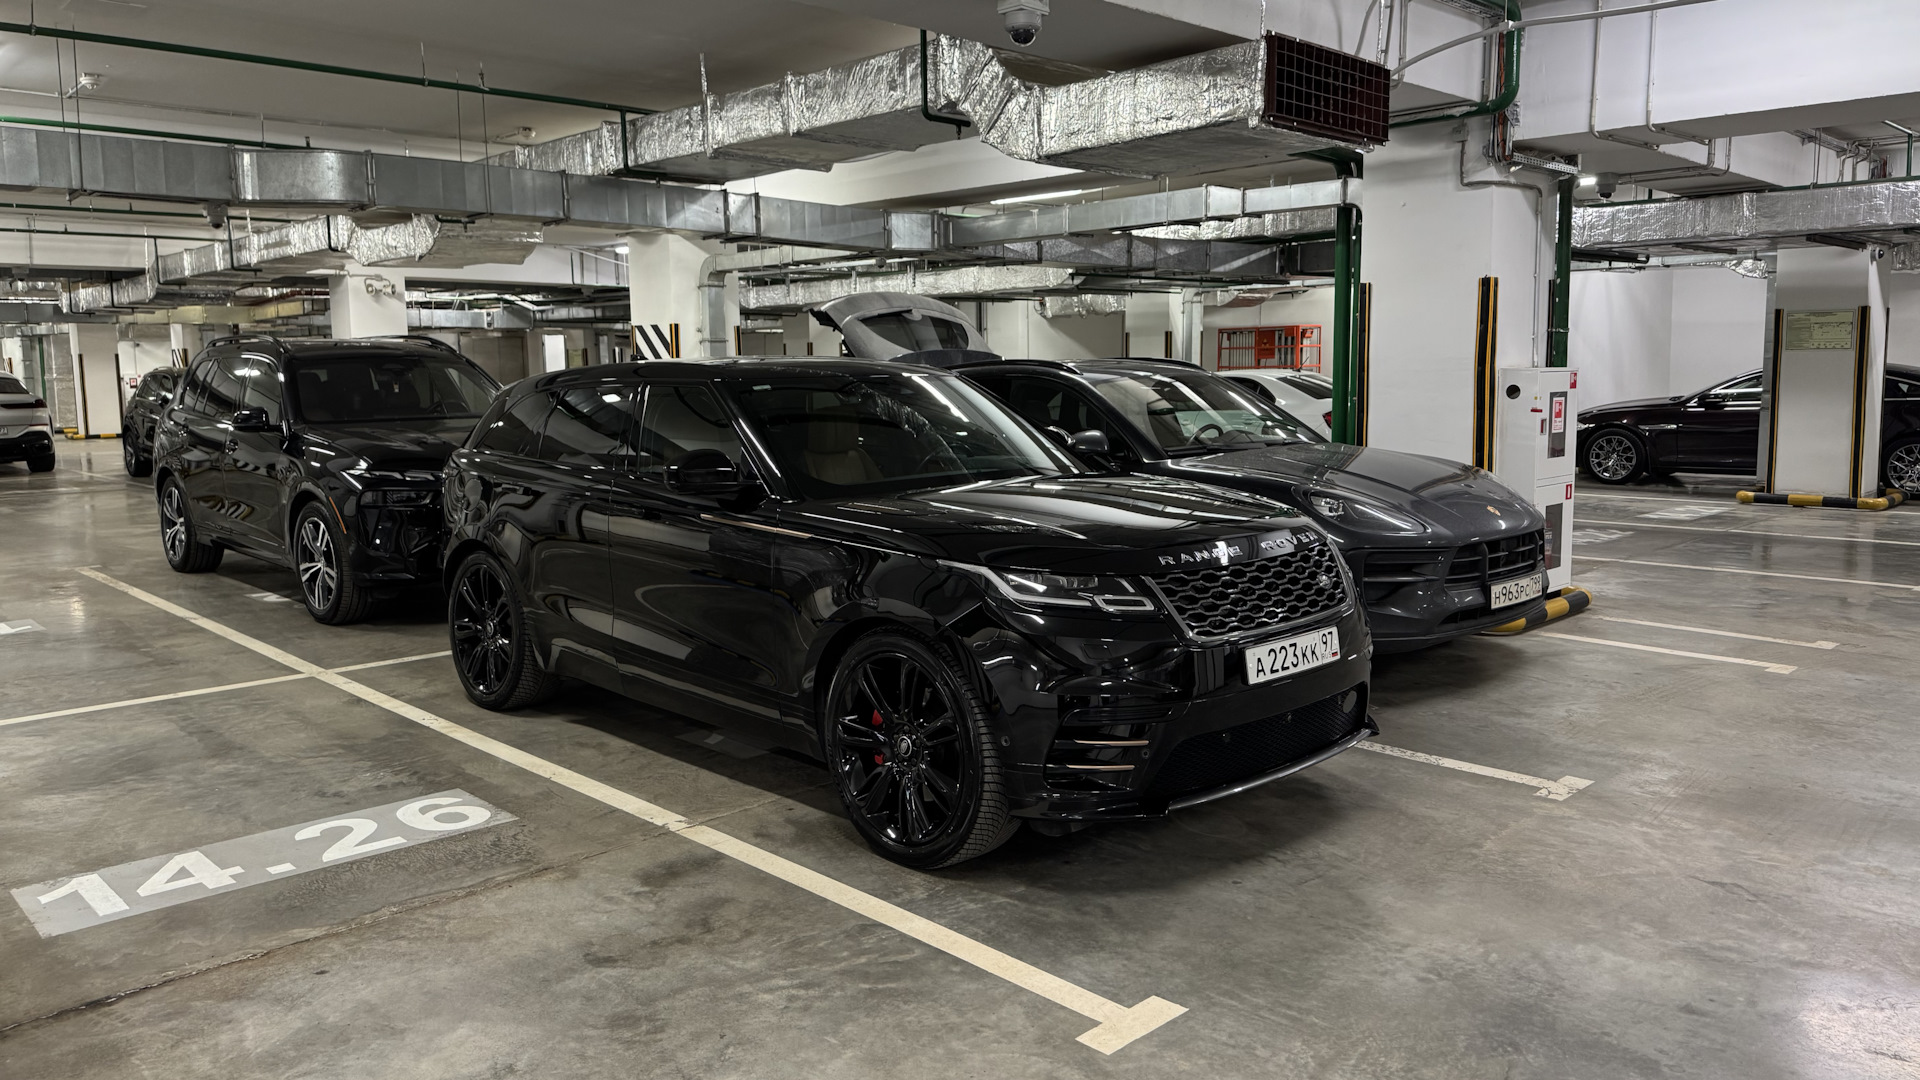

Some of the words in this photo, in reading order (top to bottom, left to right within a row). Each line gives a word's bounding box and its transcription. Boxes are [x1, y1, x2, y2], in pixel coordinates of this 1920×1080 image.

[1158, 544, 1244, 566] RANGE
[1260, 531, 1319, 552] ROVER
[1321, 631, 1333, 653] 97
[37, 797, 492, 917] 14.26
